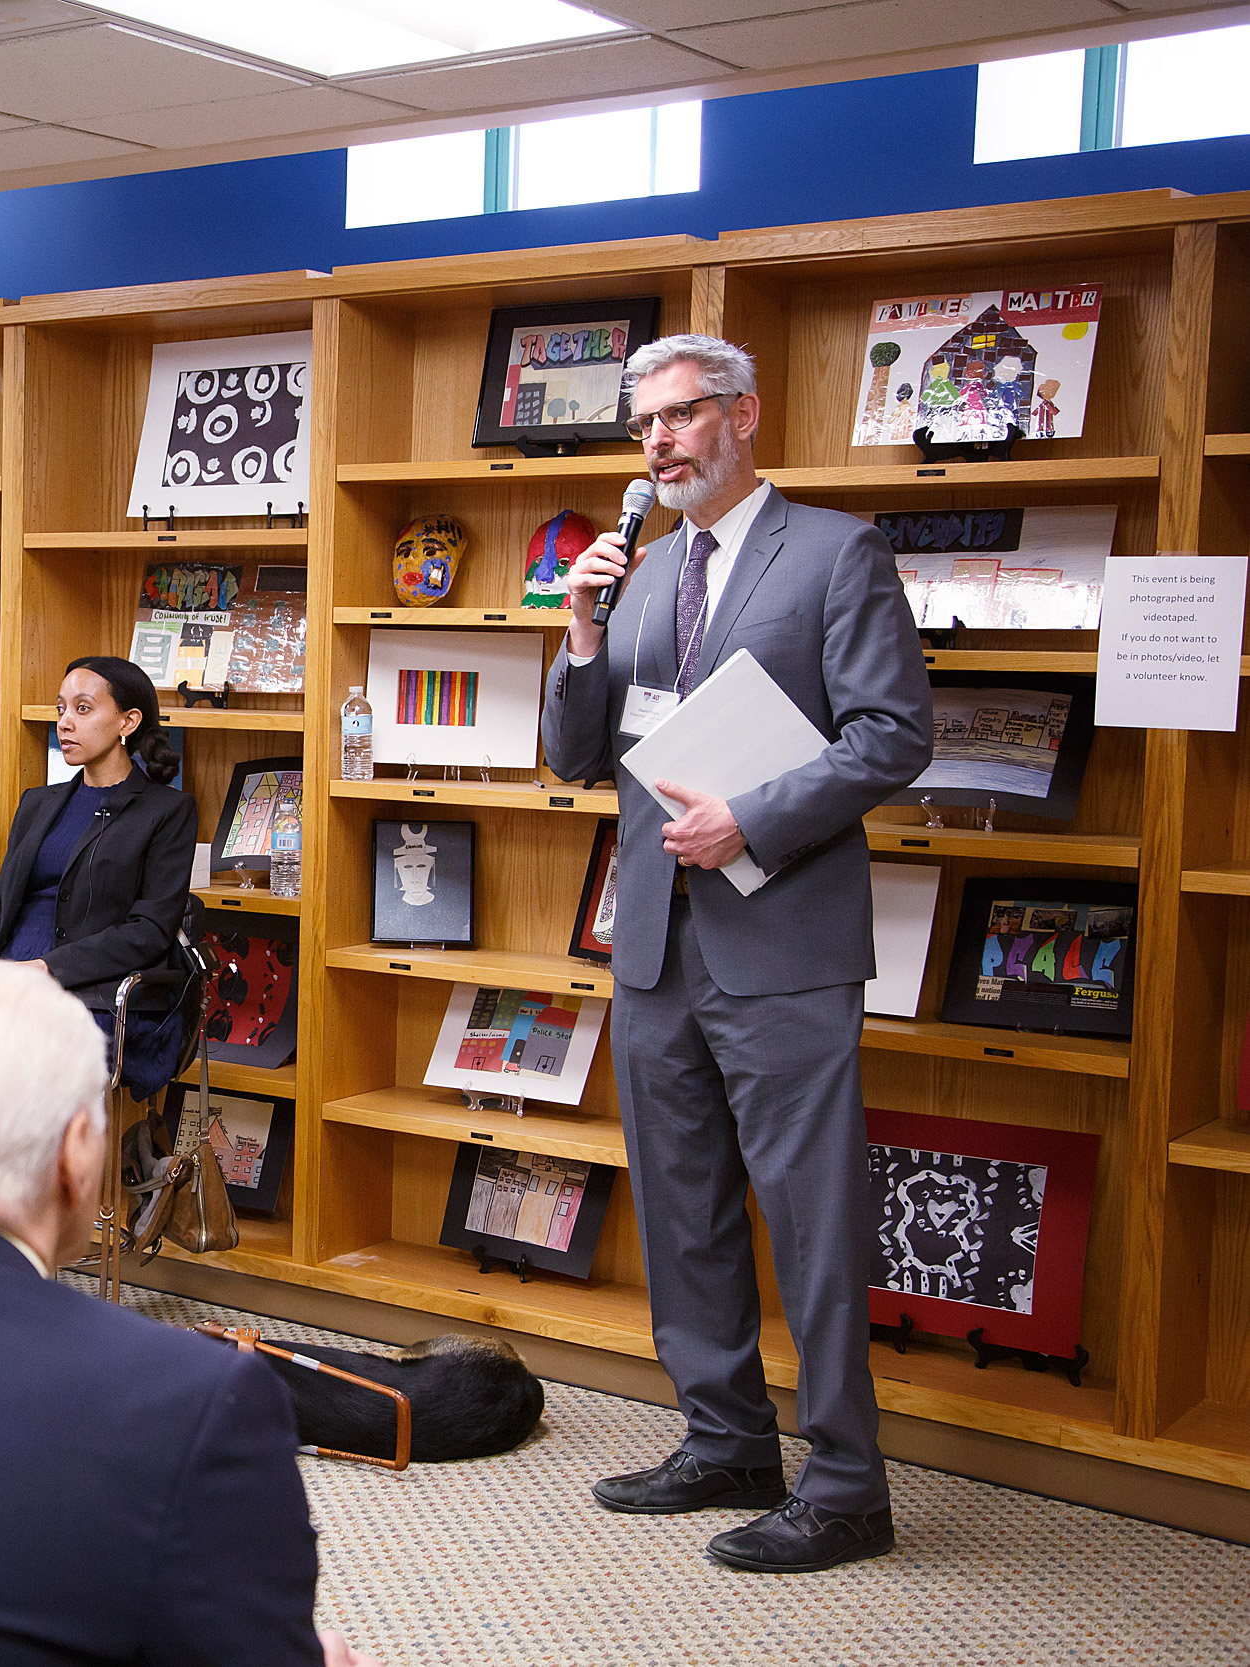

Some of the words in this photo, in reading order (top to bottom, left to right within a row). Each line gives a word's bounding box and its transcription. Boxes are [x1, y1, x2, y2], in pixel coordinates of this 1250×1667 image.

[878, 298, 972, 321] FAMILIES
[1008, 290, 1096, 312] MATTER
[1132, 575, 1149, 583] This
[1152, 576, 1177, 584] event
[1180, 575, 1187, 584] is
[1190, 575, 1215, 585] being
[1130, 594, 1194, 604] photographed
[1197, 595, 1214, 603] and
[1143, 613, 1197, 623] videotaped.
[1122, 633, 1128, 642] If
[1130, 635, 1146, 643] you
[1149, 634, 1161, 642] do
[1164, 635, 1178, 643] not
[1117, 652, 1128, 660] be
[1131, 652, 1138, 661] in
[1141, 653, 1204, 663] photos/video,
[1208, 653, 1219, 663] let
[1133, 672, 1177, 681] volunteer
[1180, 673, 1207, 682] know.
[532, 1027, 552, 1037] Police
